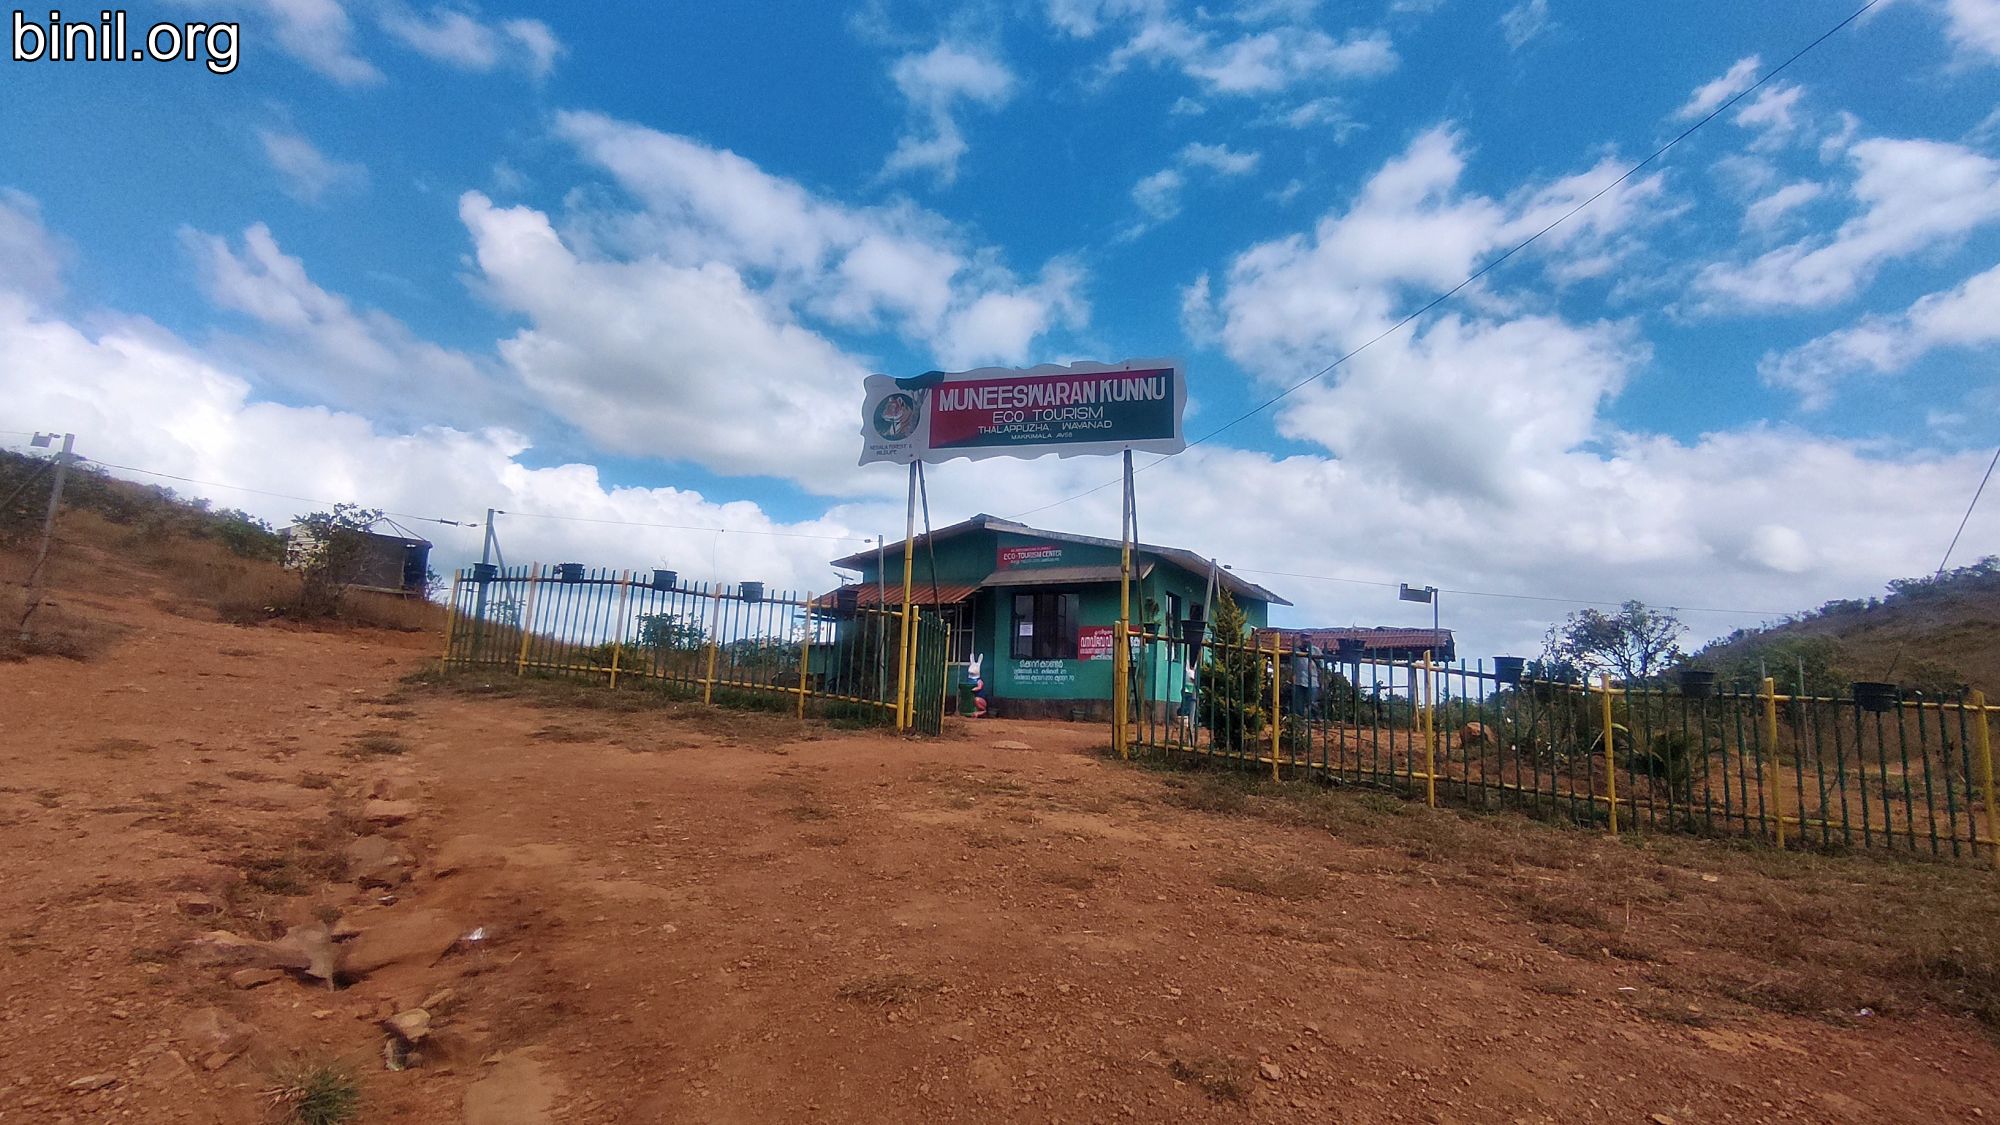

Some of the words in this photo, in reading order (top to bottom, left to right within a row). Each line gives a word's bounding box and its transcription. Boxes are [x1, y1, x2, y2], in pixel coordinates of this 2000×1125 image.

[939, 381, 1095, 411] MUNEESWARAN
[1099, 377, 1166, 403] KUNNU
[993, 409, 1025, 424] ECO
[1034, 405, 1103, 422] TOURISM
[978, 423, 1050, 435] THALAPPUZHA
[1062, 420, 1112, 431] WAYANAD
[1042, 549, 1063, 558] CENTER
